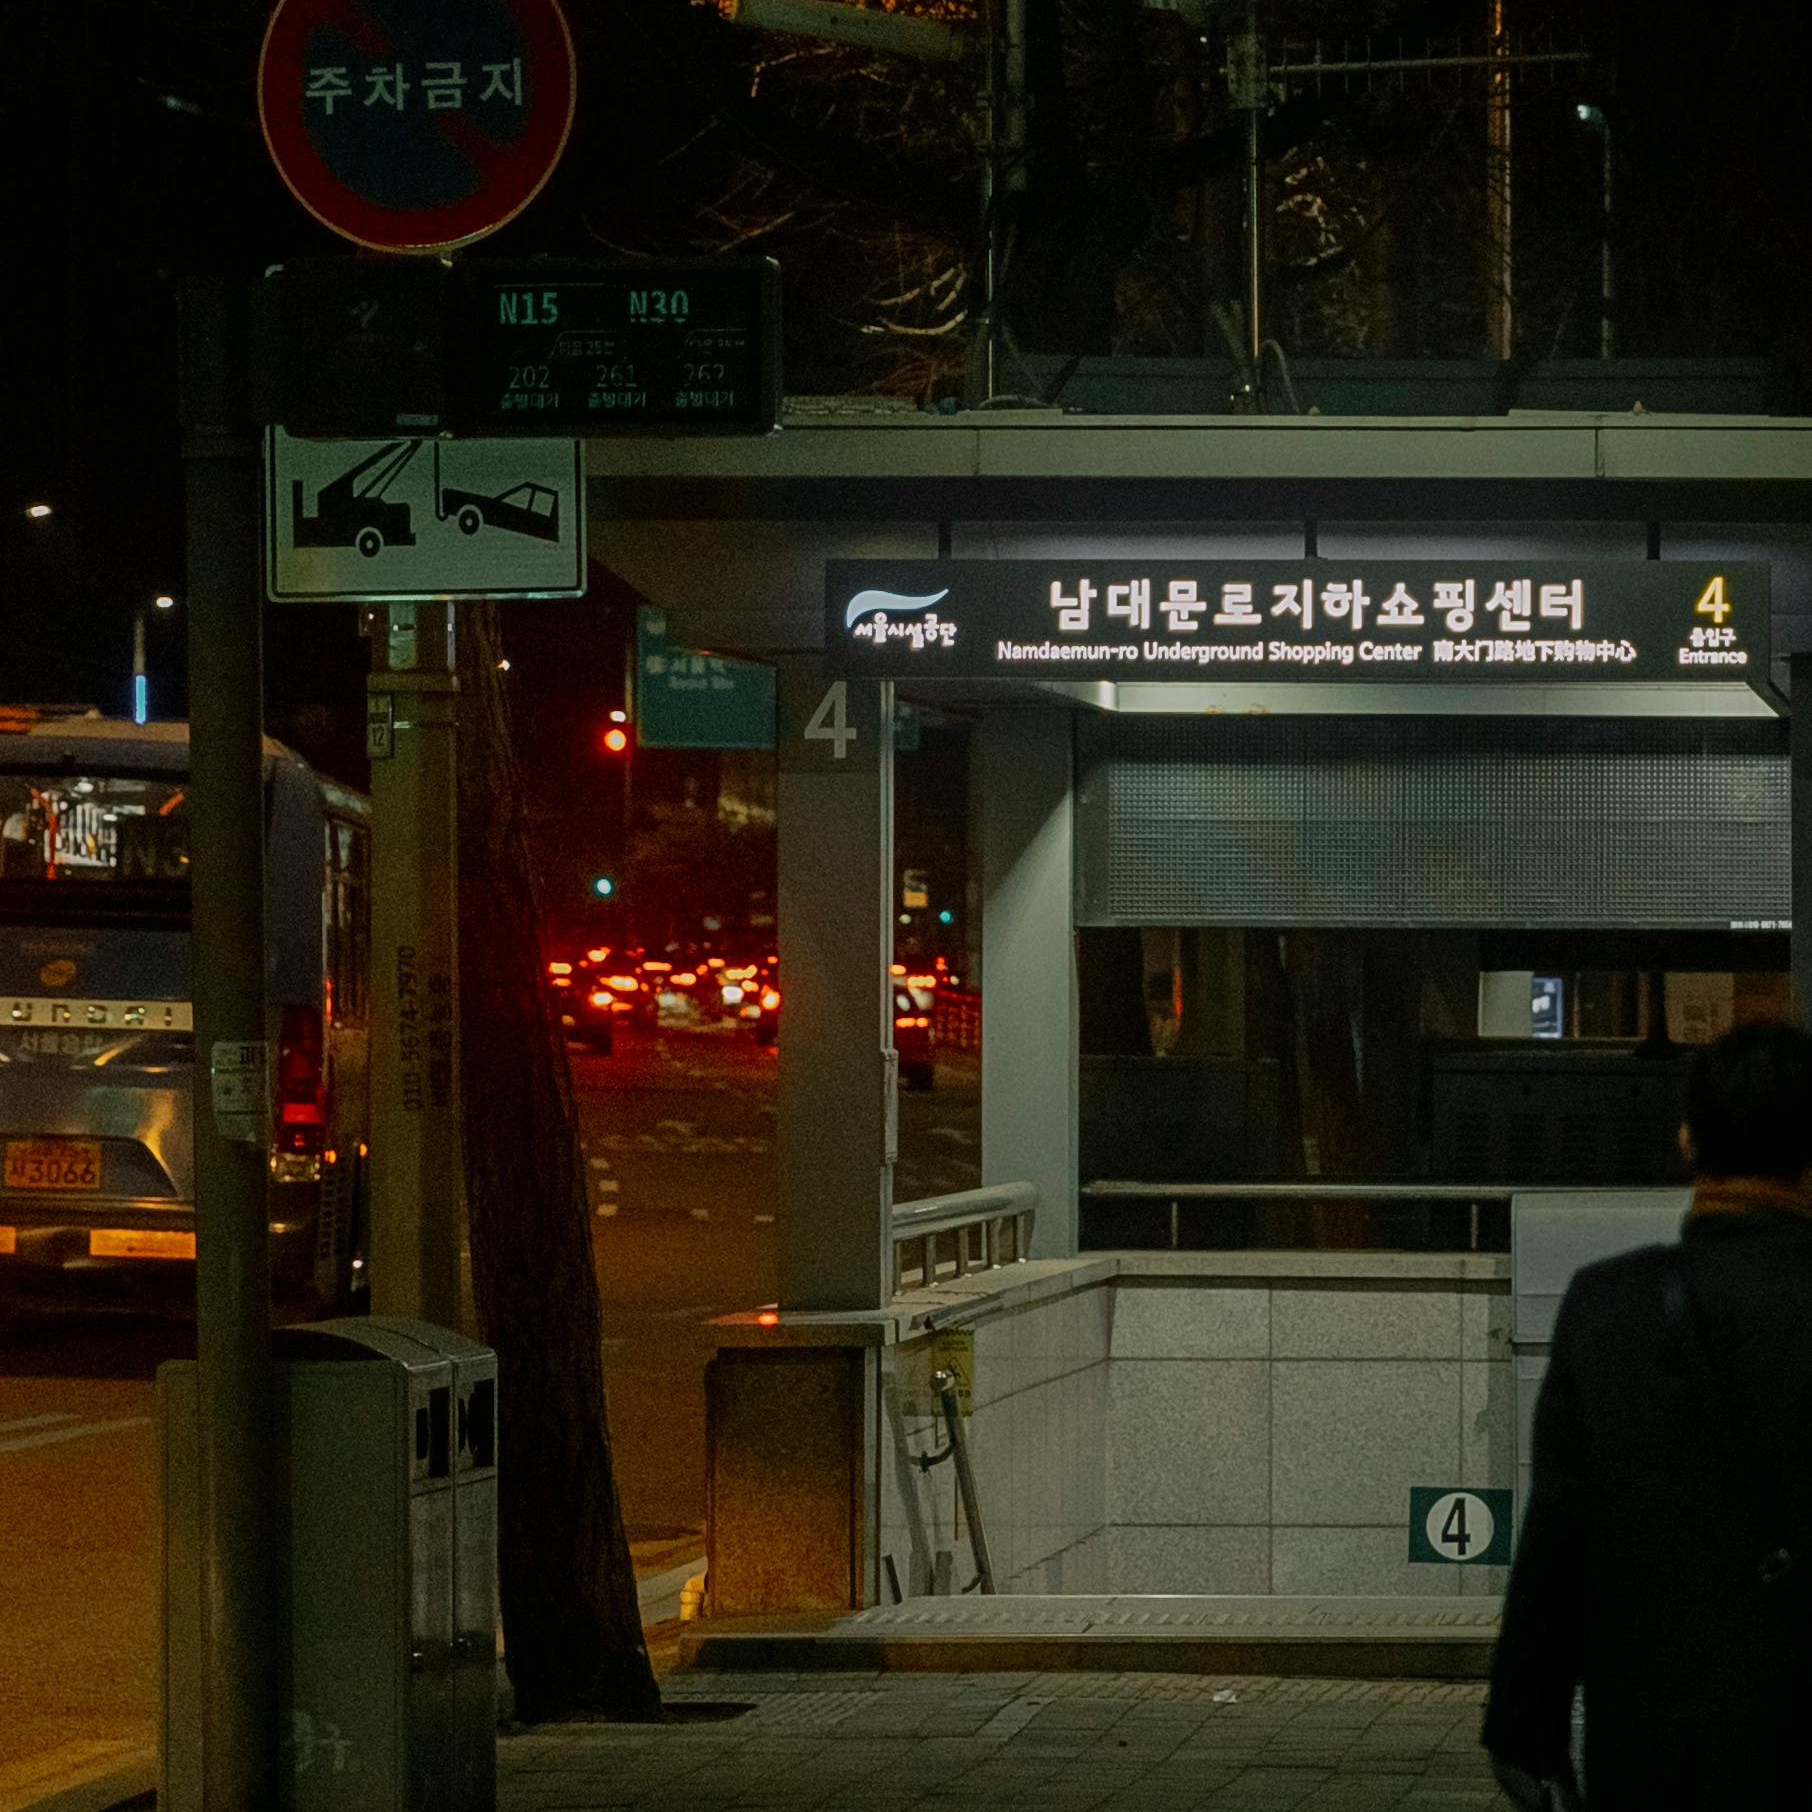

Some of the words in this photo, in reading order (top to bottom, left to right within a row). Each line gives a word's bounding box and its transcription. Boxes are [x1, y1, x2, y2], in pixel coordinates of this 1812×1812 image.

[305, 57, 524, 116] 주차금지
[499, 291, 559, 326] N15
[629, 290, 690, 324] N30
[508, 365, 550, 389] 202
[1695, 575, 1732, 624] 4
[853, 611, 958, 649] 서울시설공단
[1689, 626, 1737, 648] 출입구
[997, 640, 1139, 661] Namdaemun-ro
[1143, 640, 1264, 665] Underground
[1268, 640, 1353, 665] Shopping
[1357, 640, 1423, 661] Center
[1678, 647, 1748, 665] Entrance
[804, 680, 858, 759] 4
[1441, 1497, 1471, 1556] 4
